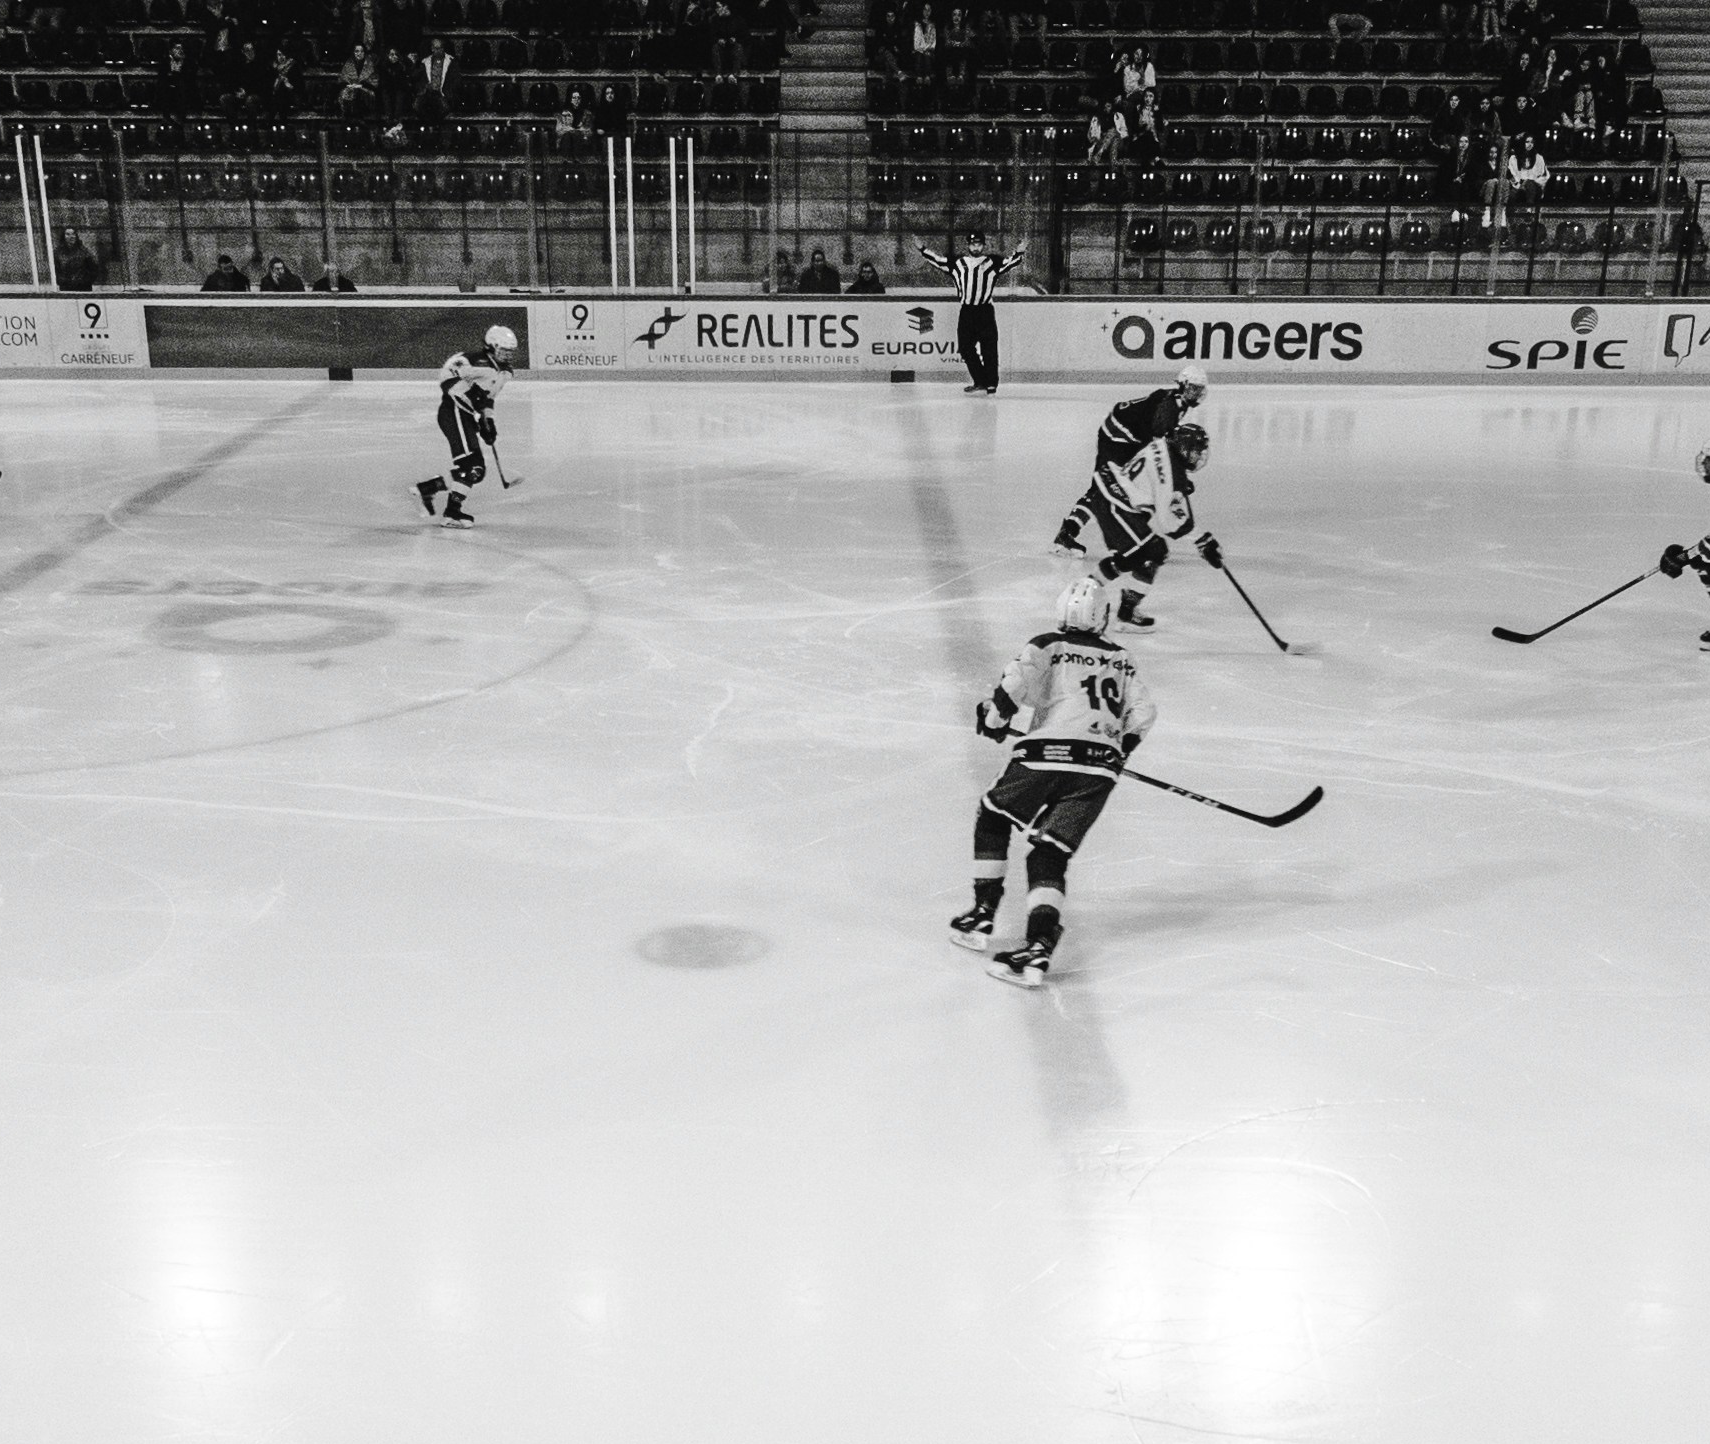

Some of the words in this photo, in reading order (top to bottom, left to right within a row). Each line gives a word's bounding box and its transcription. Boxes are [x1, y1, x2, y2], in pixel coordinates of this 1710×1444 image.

[872, 341, 961, 354] EUROVI
[1163, 320, 1364, 361] angers
[751, 355, 775, 364] DES
[780, 355, 860, 364] TERRITOIRES
[1486, 340, 1628, 369] SPIE
